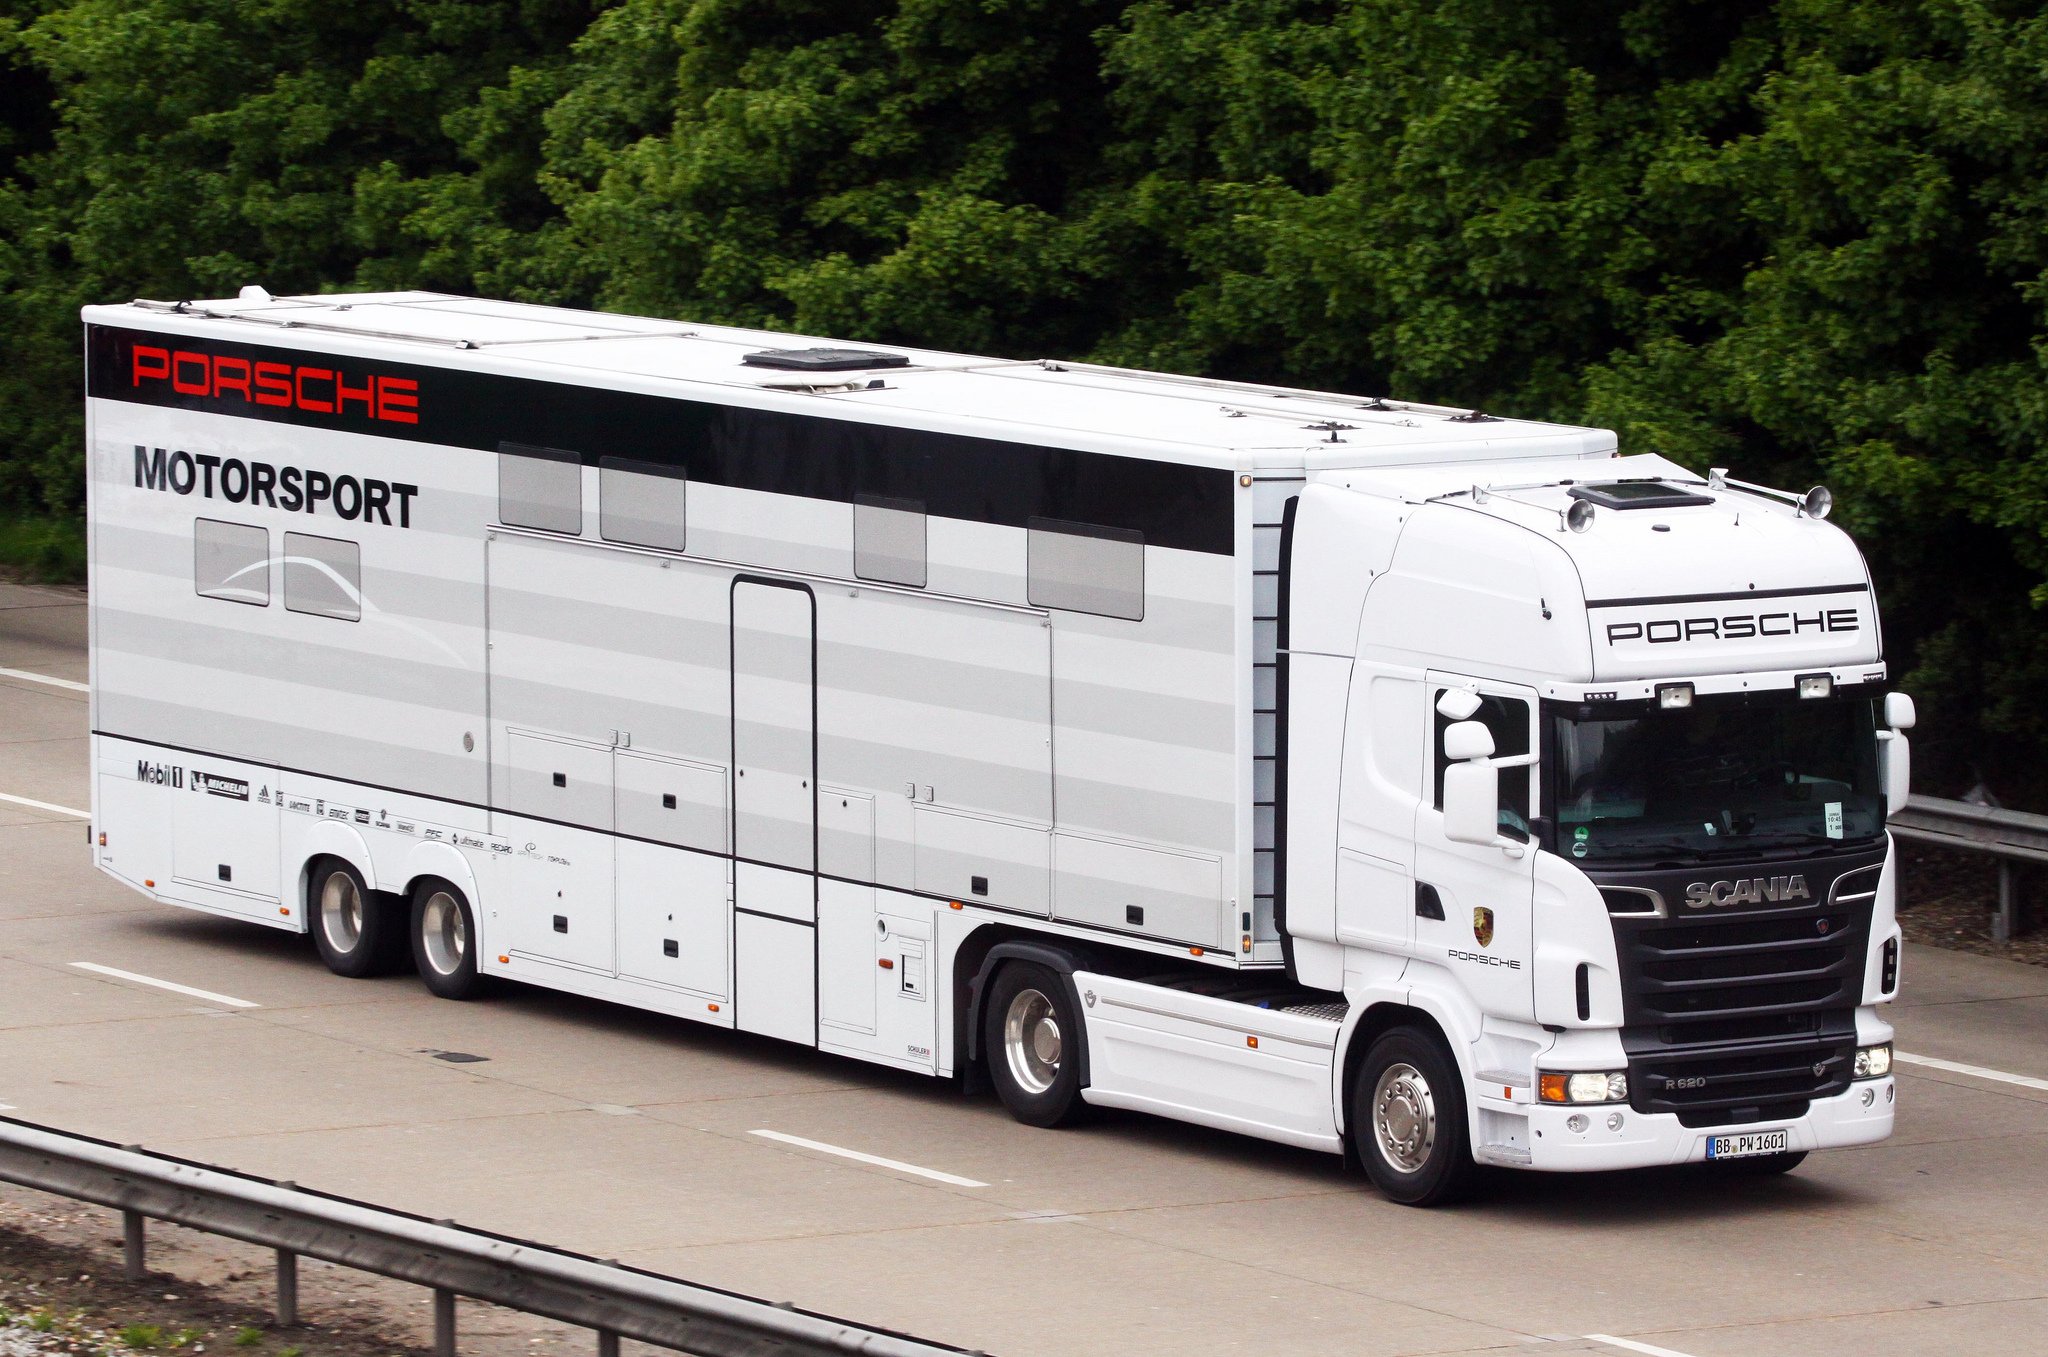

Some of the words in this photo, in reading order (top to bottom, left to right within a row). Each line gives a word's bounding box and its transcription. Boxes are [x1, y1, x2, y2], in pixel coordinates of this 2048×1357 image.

[132, 345, 419, 425] PORSCHE
[134, 445, 418, 529] MOTORSPORT
[1606, 608, 1860, 647] PORSCHE
[138, 760, 170, 787] Mobil
[172, 766, 183, 788] 1
[208, 778, 248, 796] MICHELIN
[460, 837, 484, 849] ultimate
[491, 842, 513, 854] RECARO
[1685, 874, 1811, 909] SCANIA
[1448, 949, 1521, 970] PORSCHE
[1665, 1079, 1675, 1090] R
[1677, 1077, 1706, 1089] 620
[1716, 1139, 1730, 1154] BB
